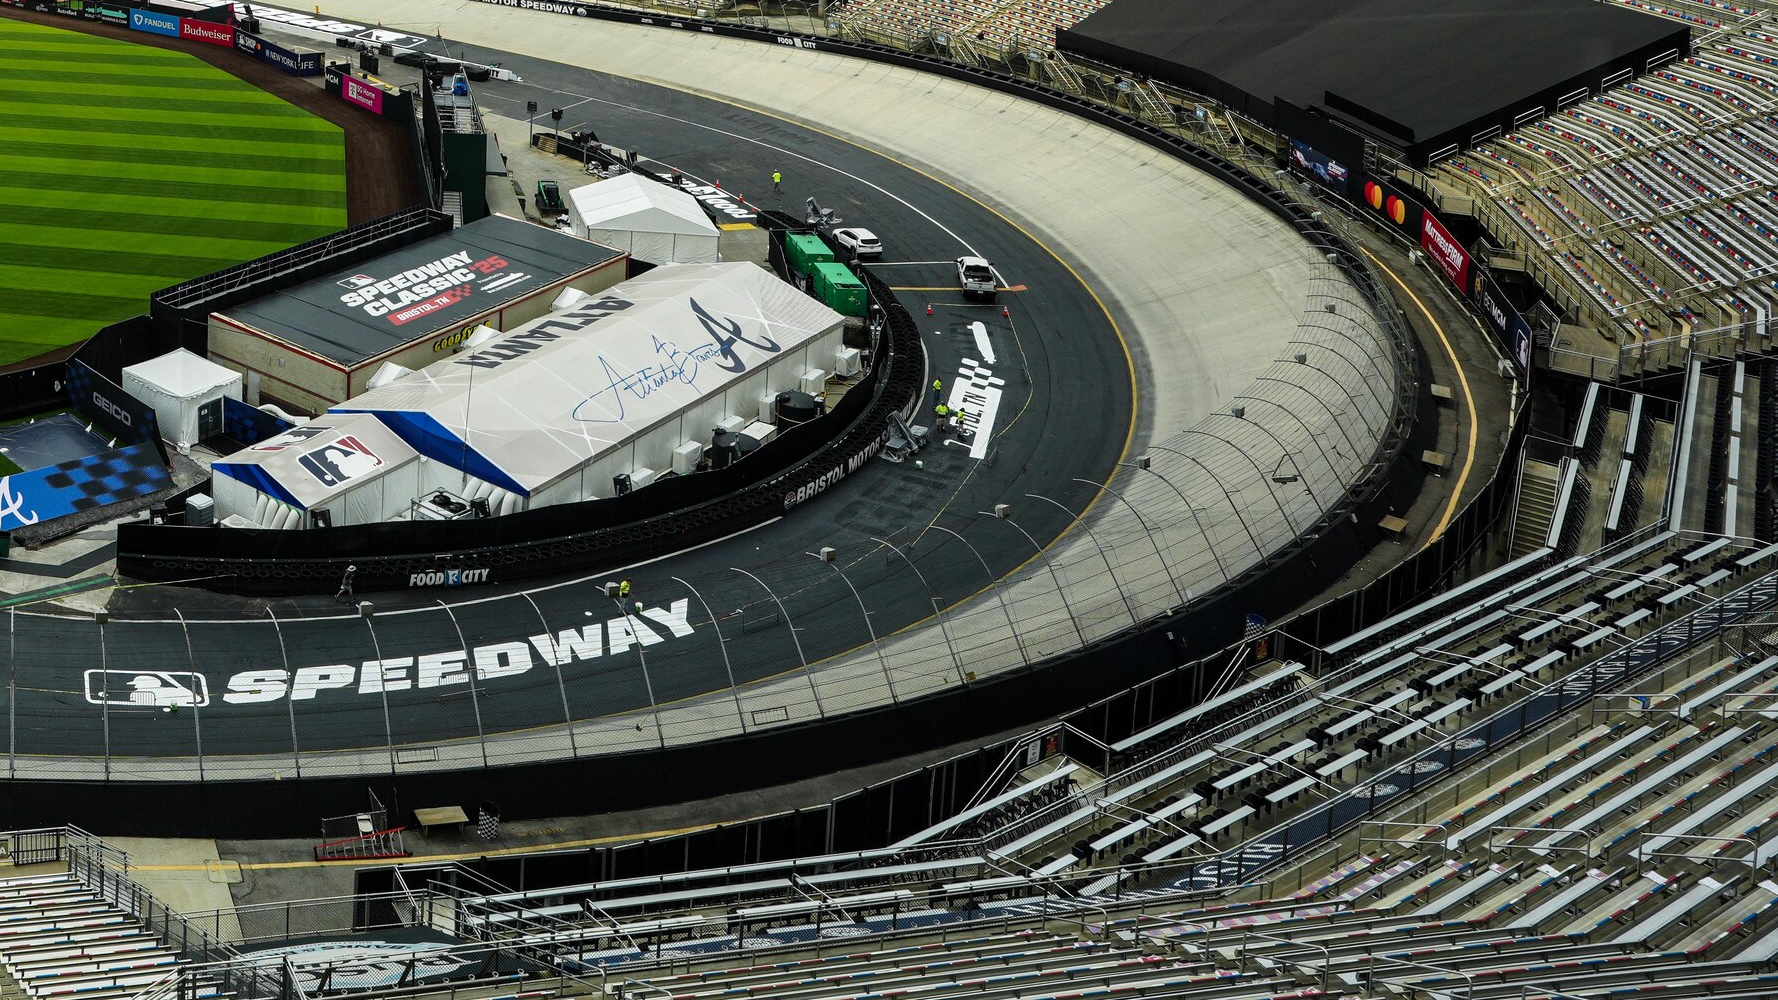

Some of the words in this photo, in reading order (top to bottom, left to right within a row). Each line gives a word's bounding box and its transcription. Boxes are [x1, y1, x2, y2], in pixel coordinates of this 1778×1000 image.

[520, 0, 575, 15] SPEEDWAY
[144, 18, 175, 30] FANDUEL
[183, 24, 231, 42] Budweiser
[244, 36, 256, 50] SHOP
[777, 36, 793, 46] FOOD
[803, 40, 816, 49] CITY
[270, 51, 282, 64] NEW
[281, 55, 294, 68] YORK
[294, 60, 314, 70] LIFE
[357, 94, 374, 107] Internet
[364, 88, 375, 99] Home
[705, 198, 757, 218] FOOD
[1425, 219, 1449, 253] MATTRESS
[1446, 243, 1464, 268] FIRM
[340, 250, 473, 307] SPEEDWAY
[363, 268, 476, 317] CLASSIC
[396, 300, 438, 321] BRISTOL,
[436, 296, 450, 307] TN
[1483, 292, 1507, 331] BETMGM
[454, 295, 635, 369] ATLANTA
[93, 391, 132, 426] GEICO
[796, 466, 846, 505] BRISTOL
[848, 440, 881, 474] MOTOR
[409, 572, 445, 587] FOOD
[462, 568, 490, 584] CITY
[222, 597, 697, 705] SPEEDWAY
